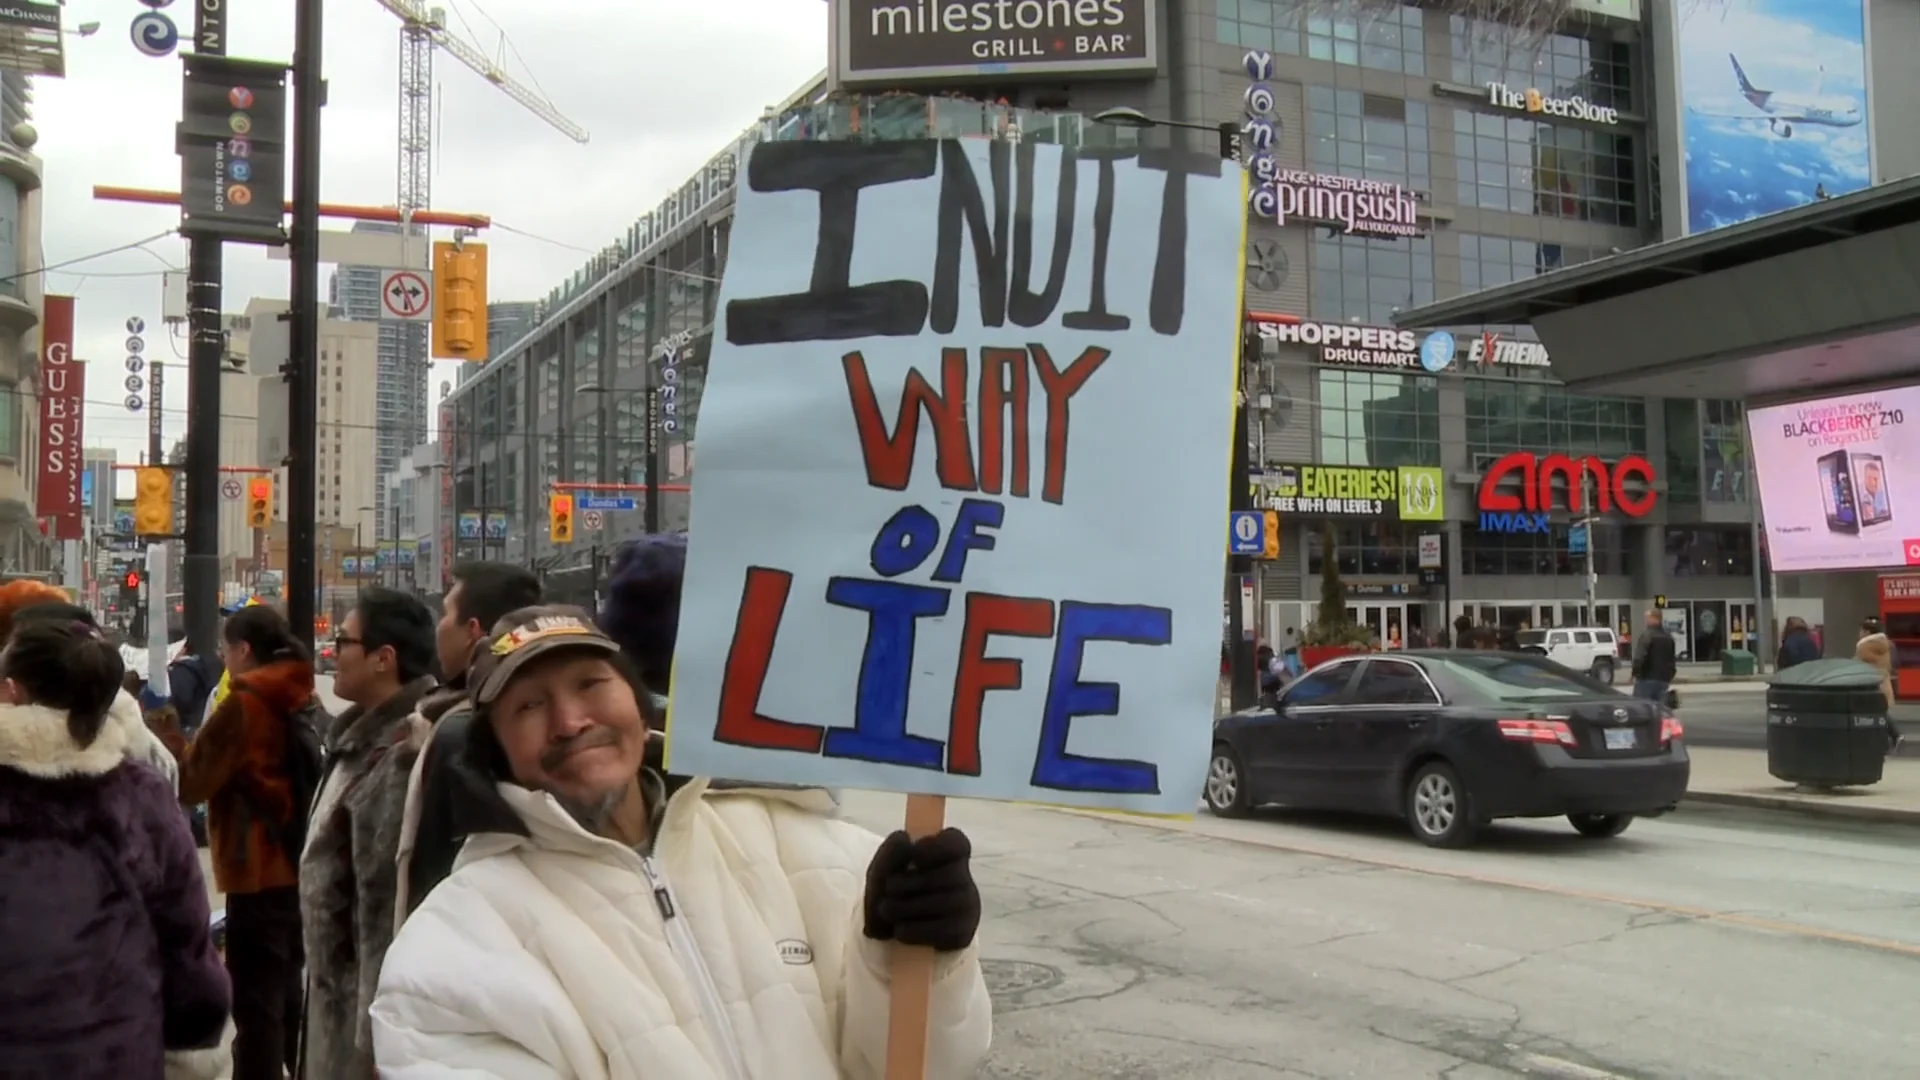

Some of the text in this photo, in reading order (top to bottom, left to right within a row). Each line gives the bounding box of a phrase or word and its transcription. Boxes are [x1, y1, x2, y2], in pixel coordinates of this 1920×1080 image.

[871, 0, 1125, 35] milestones
[972, 38, 1045, 58] GRILL
[215, 141, 224, 212] DOWNTOWN
[1316, 174, 1393, 195] RESTAURANT
[726, 137, 1222, 346] INUIT
[1258, 322, 1416, 351] SHOPPERS
[1324, 347, 1418, 367] DRUG MART
[46, 342, 68, 474] GUESS
[152, 367, 161, 434] DOWNTOWN
[1879, 409, 1905, 426] Z10
[649, 391, 657, 453] DOWNTOWN
[842, 343, 1111, 504] WAY
[1301, 466, 1397, 500] EATERIES!
[1270, 498, 1295, 512] FREE
[1326, 498, 1341, 513] ON
[1343, 500, 1373, 513] LEVEL
[1374, 500, 1382, 514] 3
[1480, 513, 1551, 533] IMAX
[871, 498, 1005, 582] OF
[714, 566, 1172, 794] LIFE
